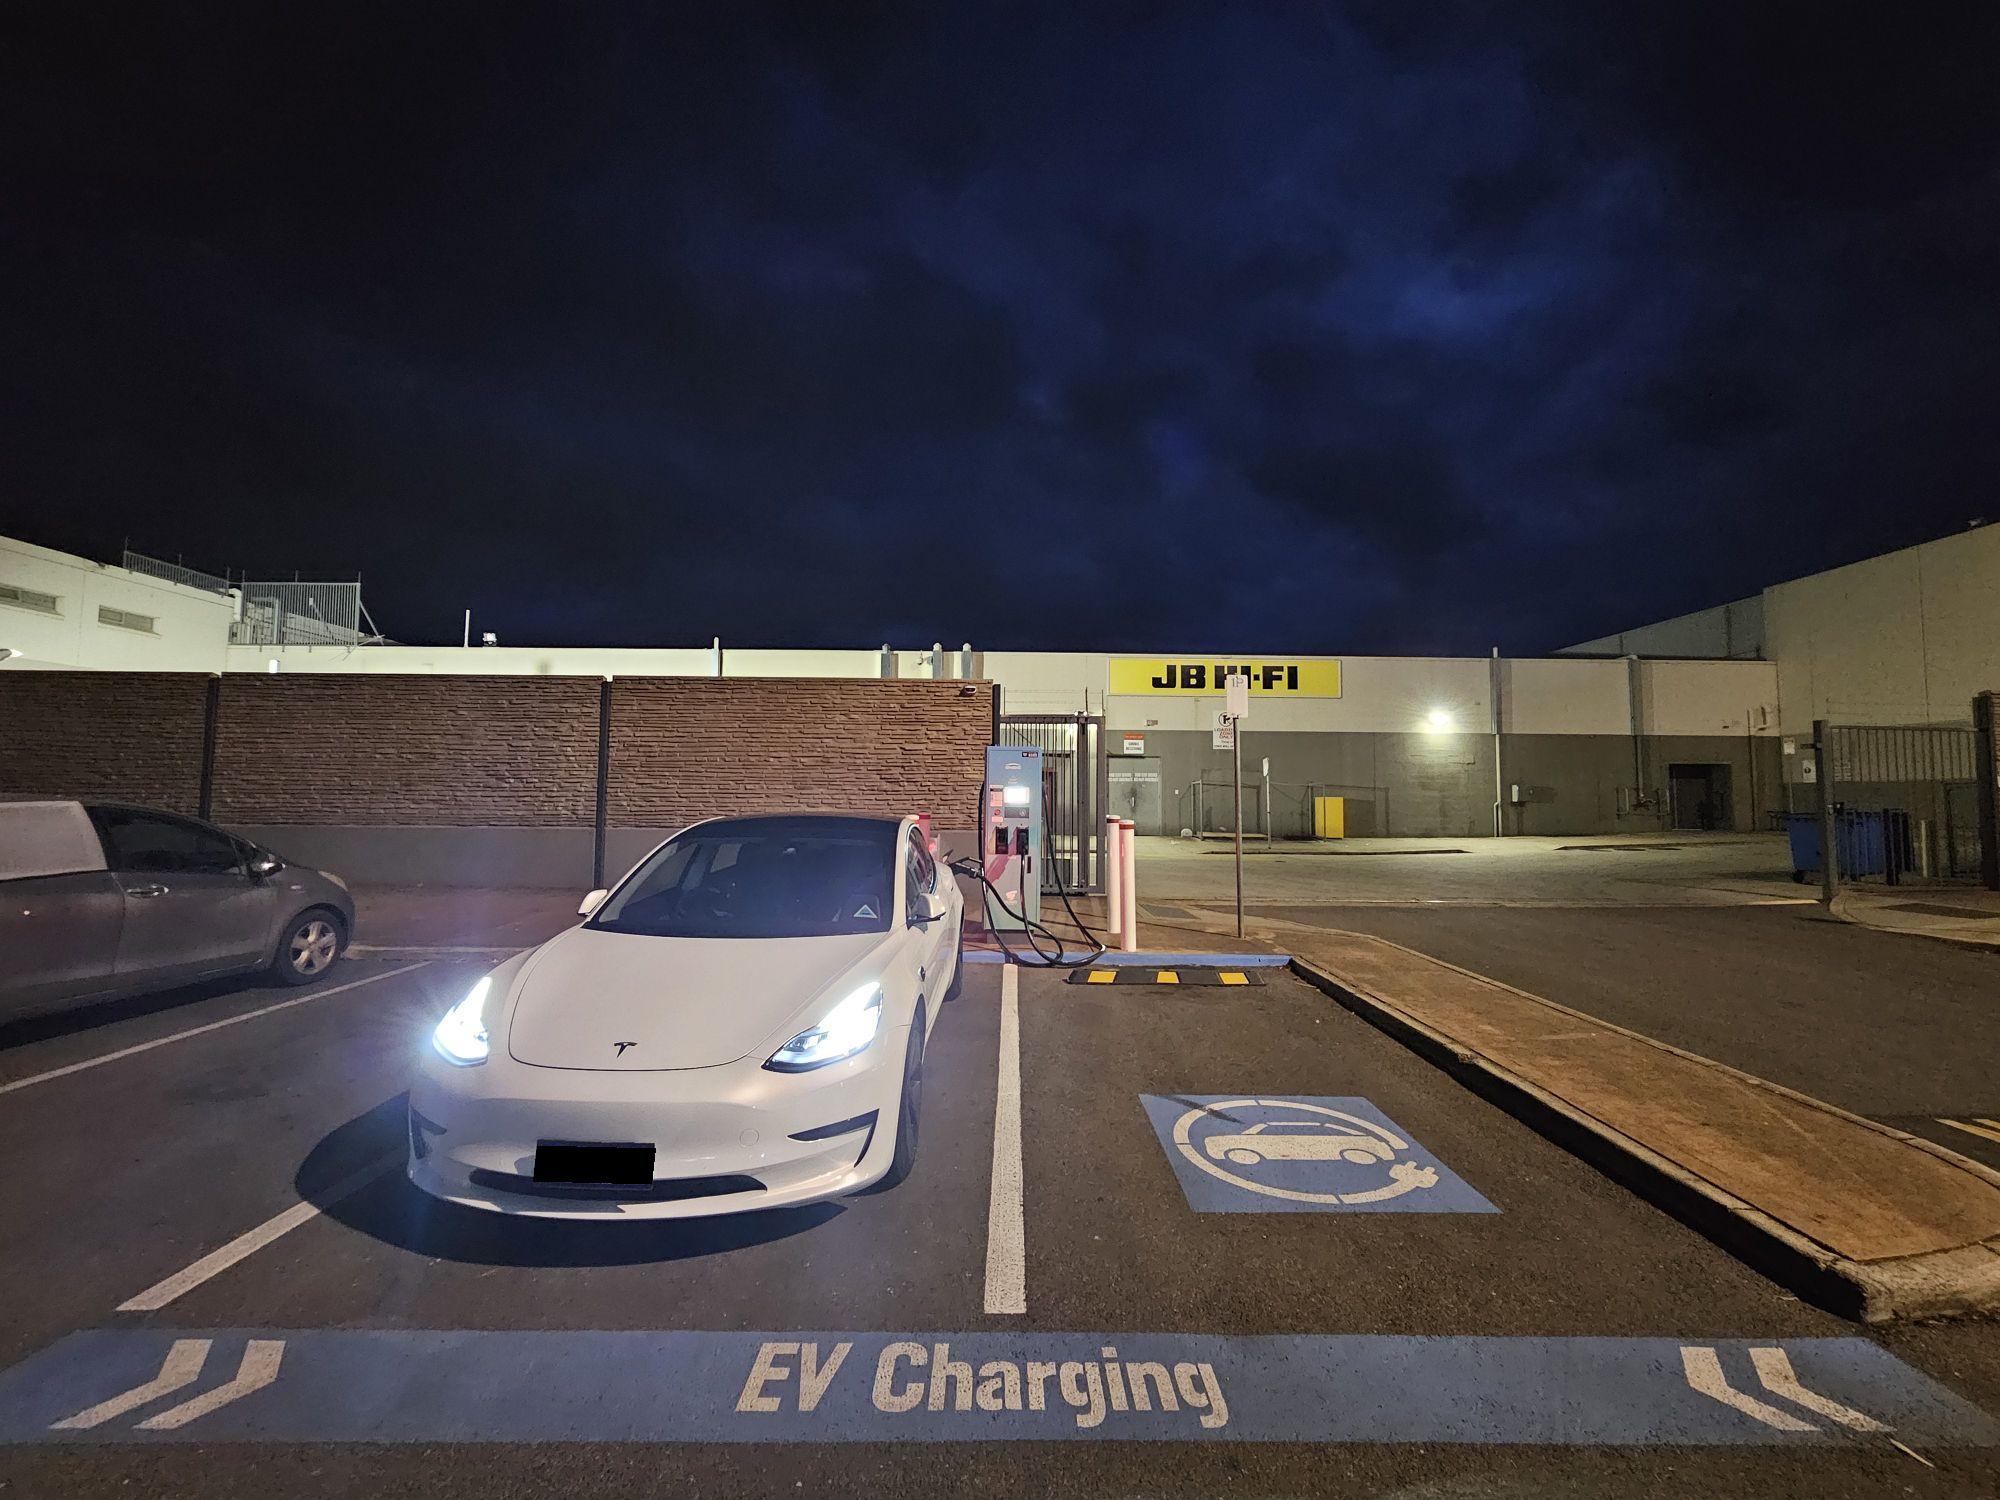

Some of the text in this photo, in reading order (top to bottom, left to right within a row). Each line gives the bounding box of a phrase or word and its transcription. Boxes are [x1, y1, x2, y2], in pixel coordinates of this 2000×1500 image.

[1152, 664, 1206, 689] JB
[735, 1341, 1230, 1429] EV Charging
